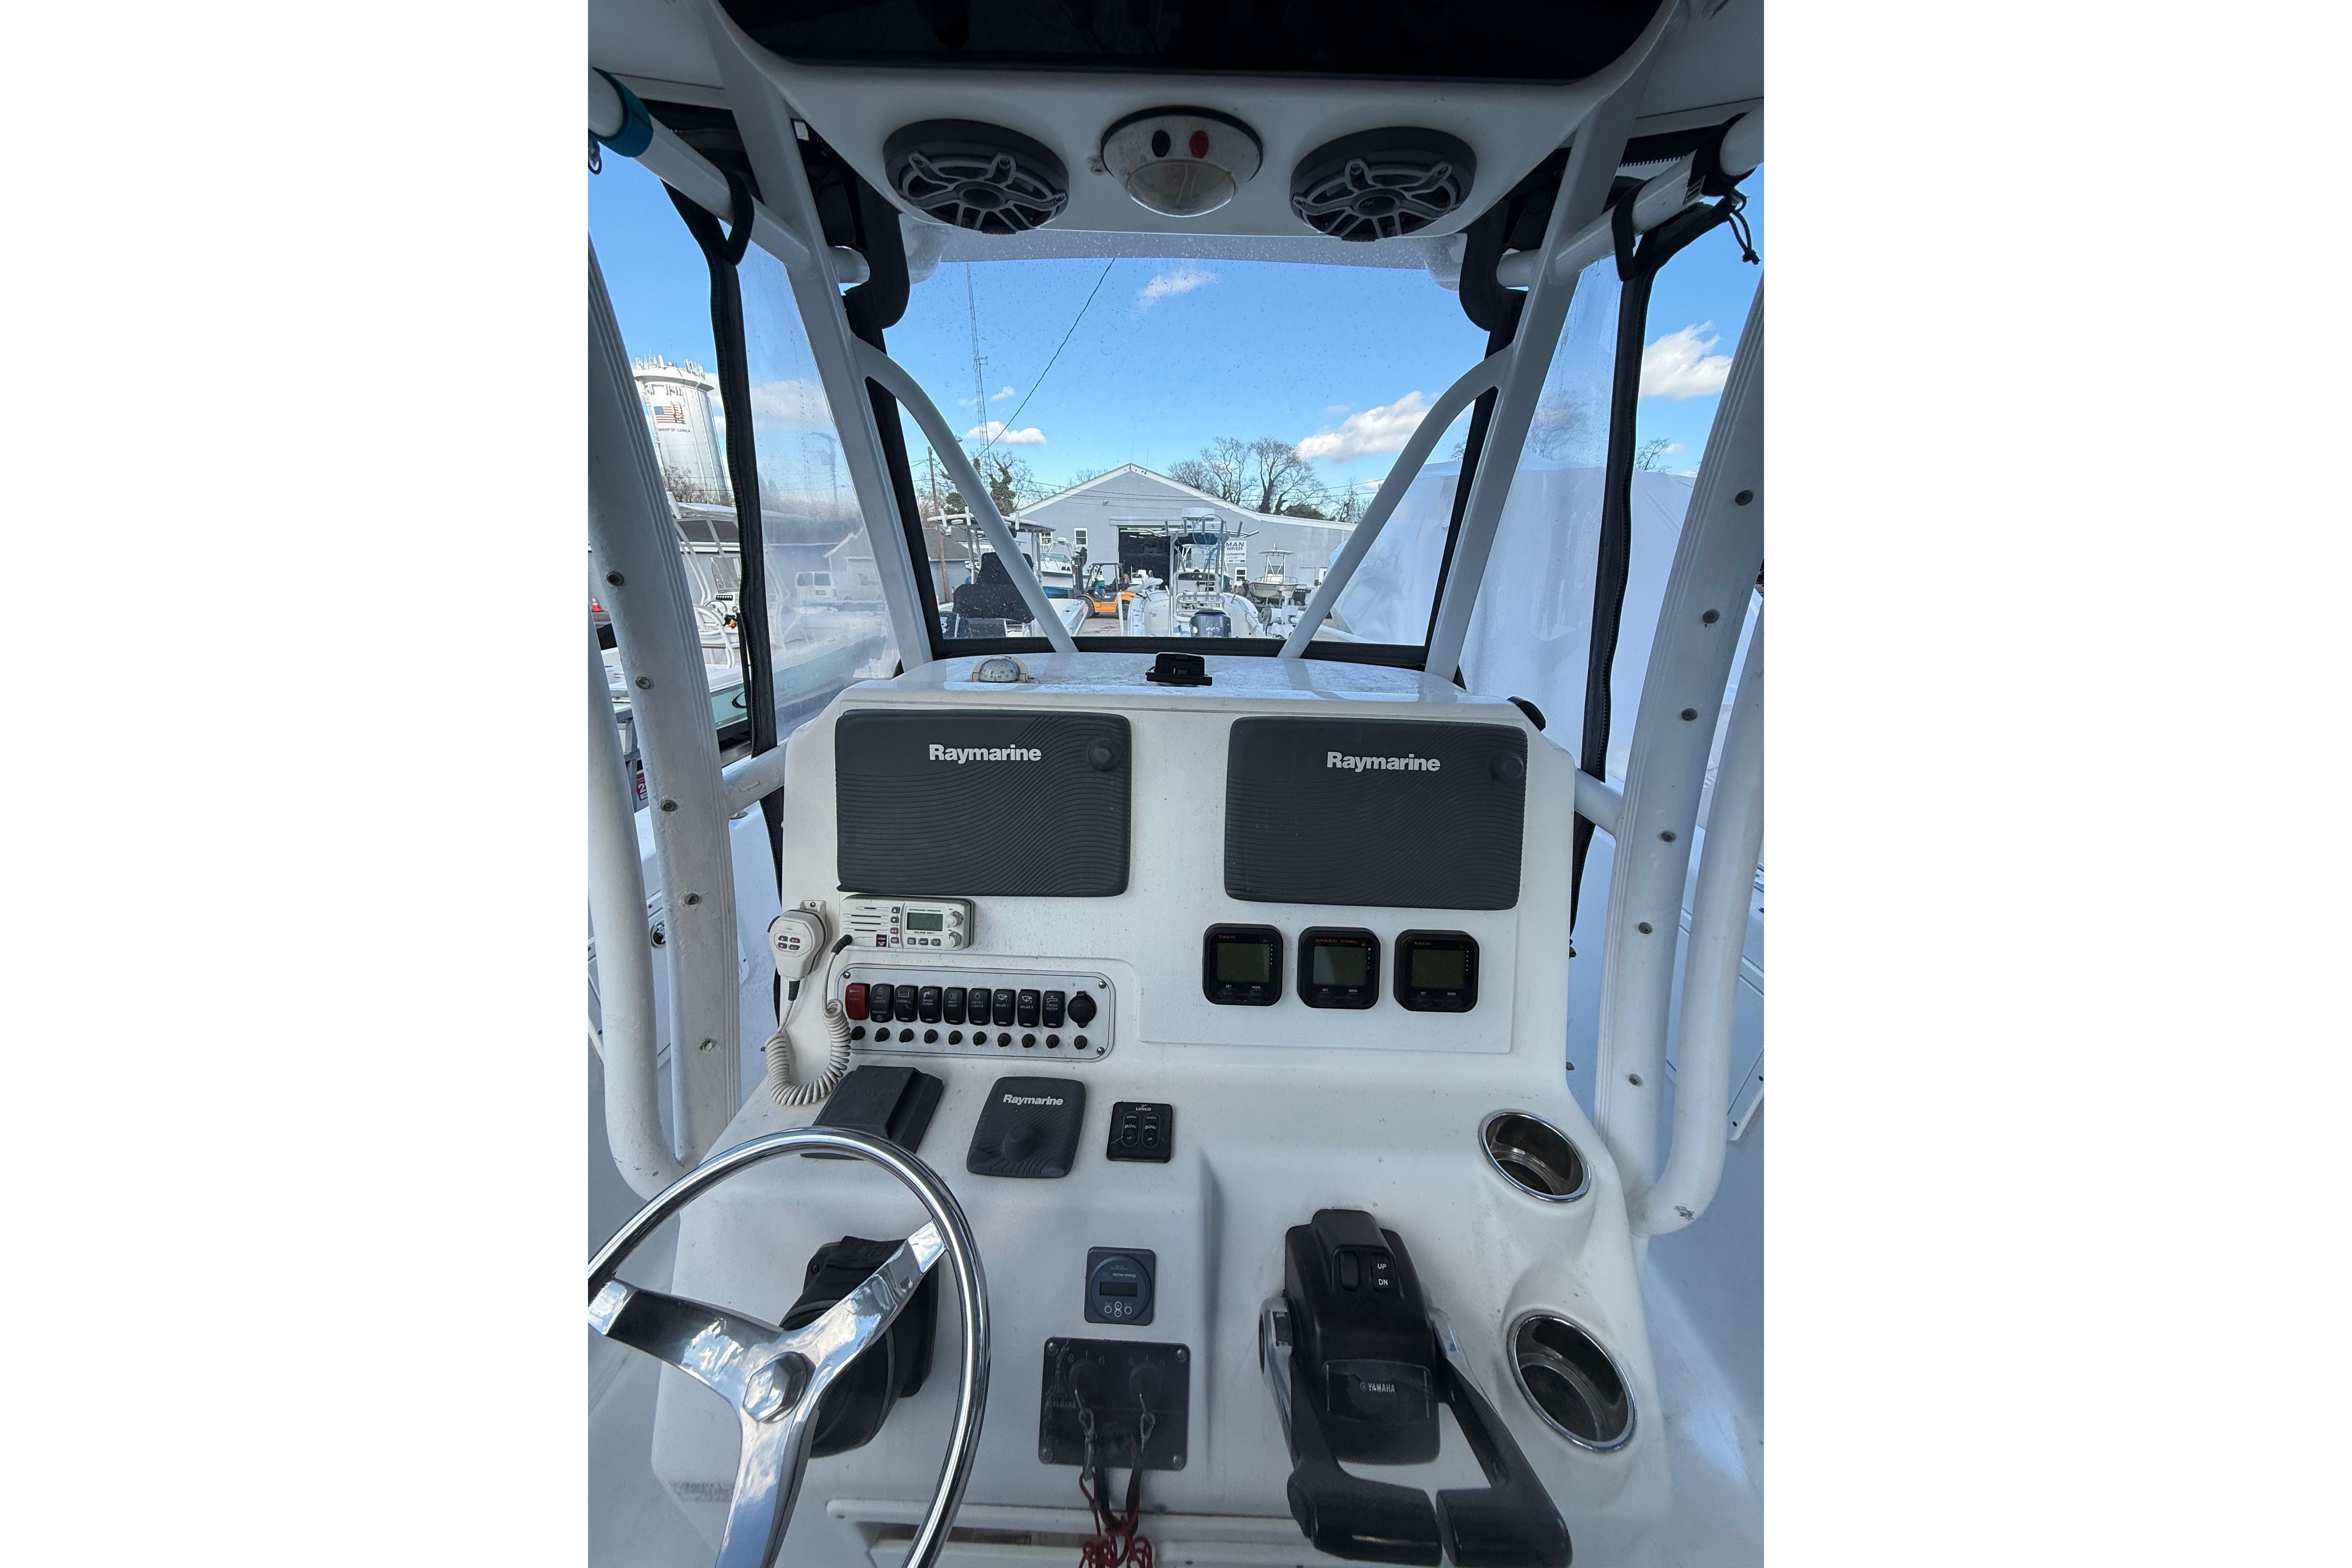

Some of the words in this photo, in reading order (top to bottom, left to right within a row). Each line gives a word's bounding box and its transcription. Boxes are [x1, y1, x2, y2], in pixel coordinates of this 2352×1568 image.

[929, 744, 1042, 764] Raymarine
[1327, 752, 1440, 772] Raymarine
[1003, 1094, 1064, 1105] Raymarine
[1368, 1382, 1395, 1393] YAMAHA
[1052, 1400, 1076, 1409] YAMAHA
